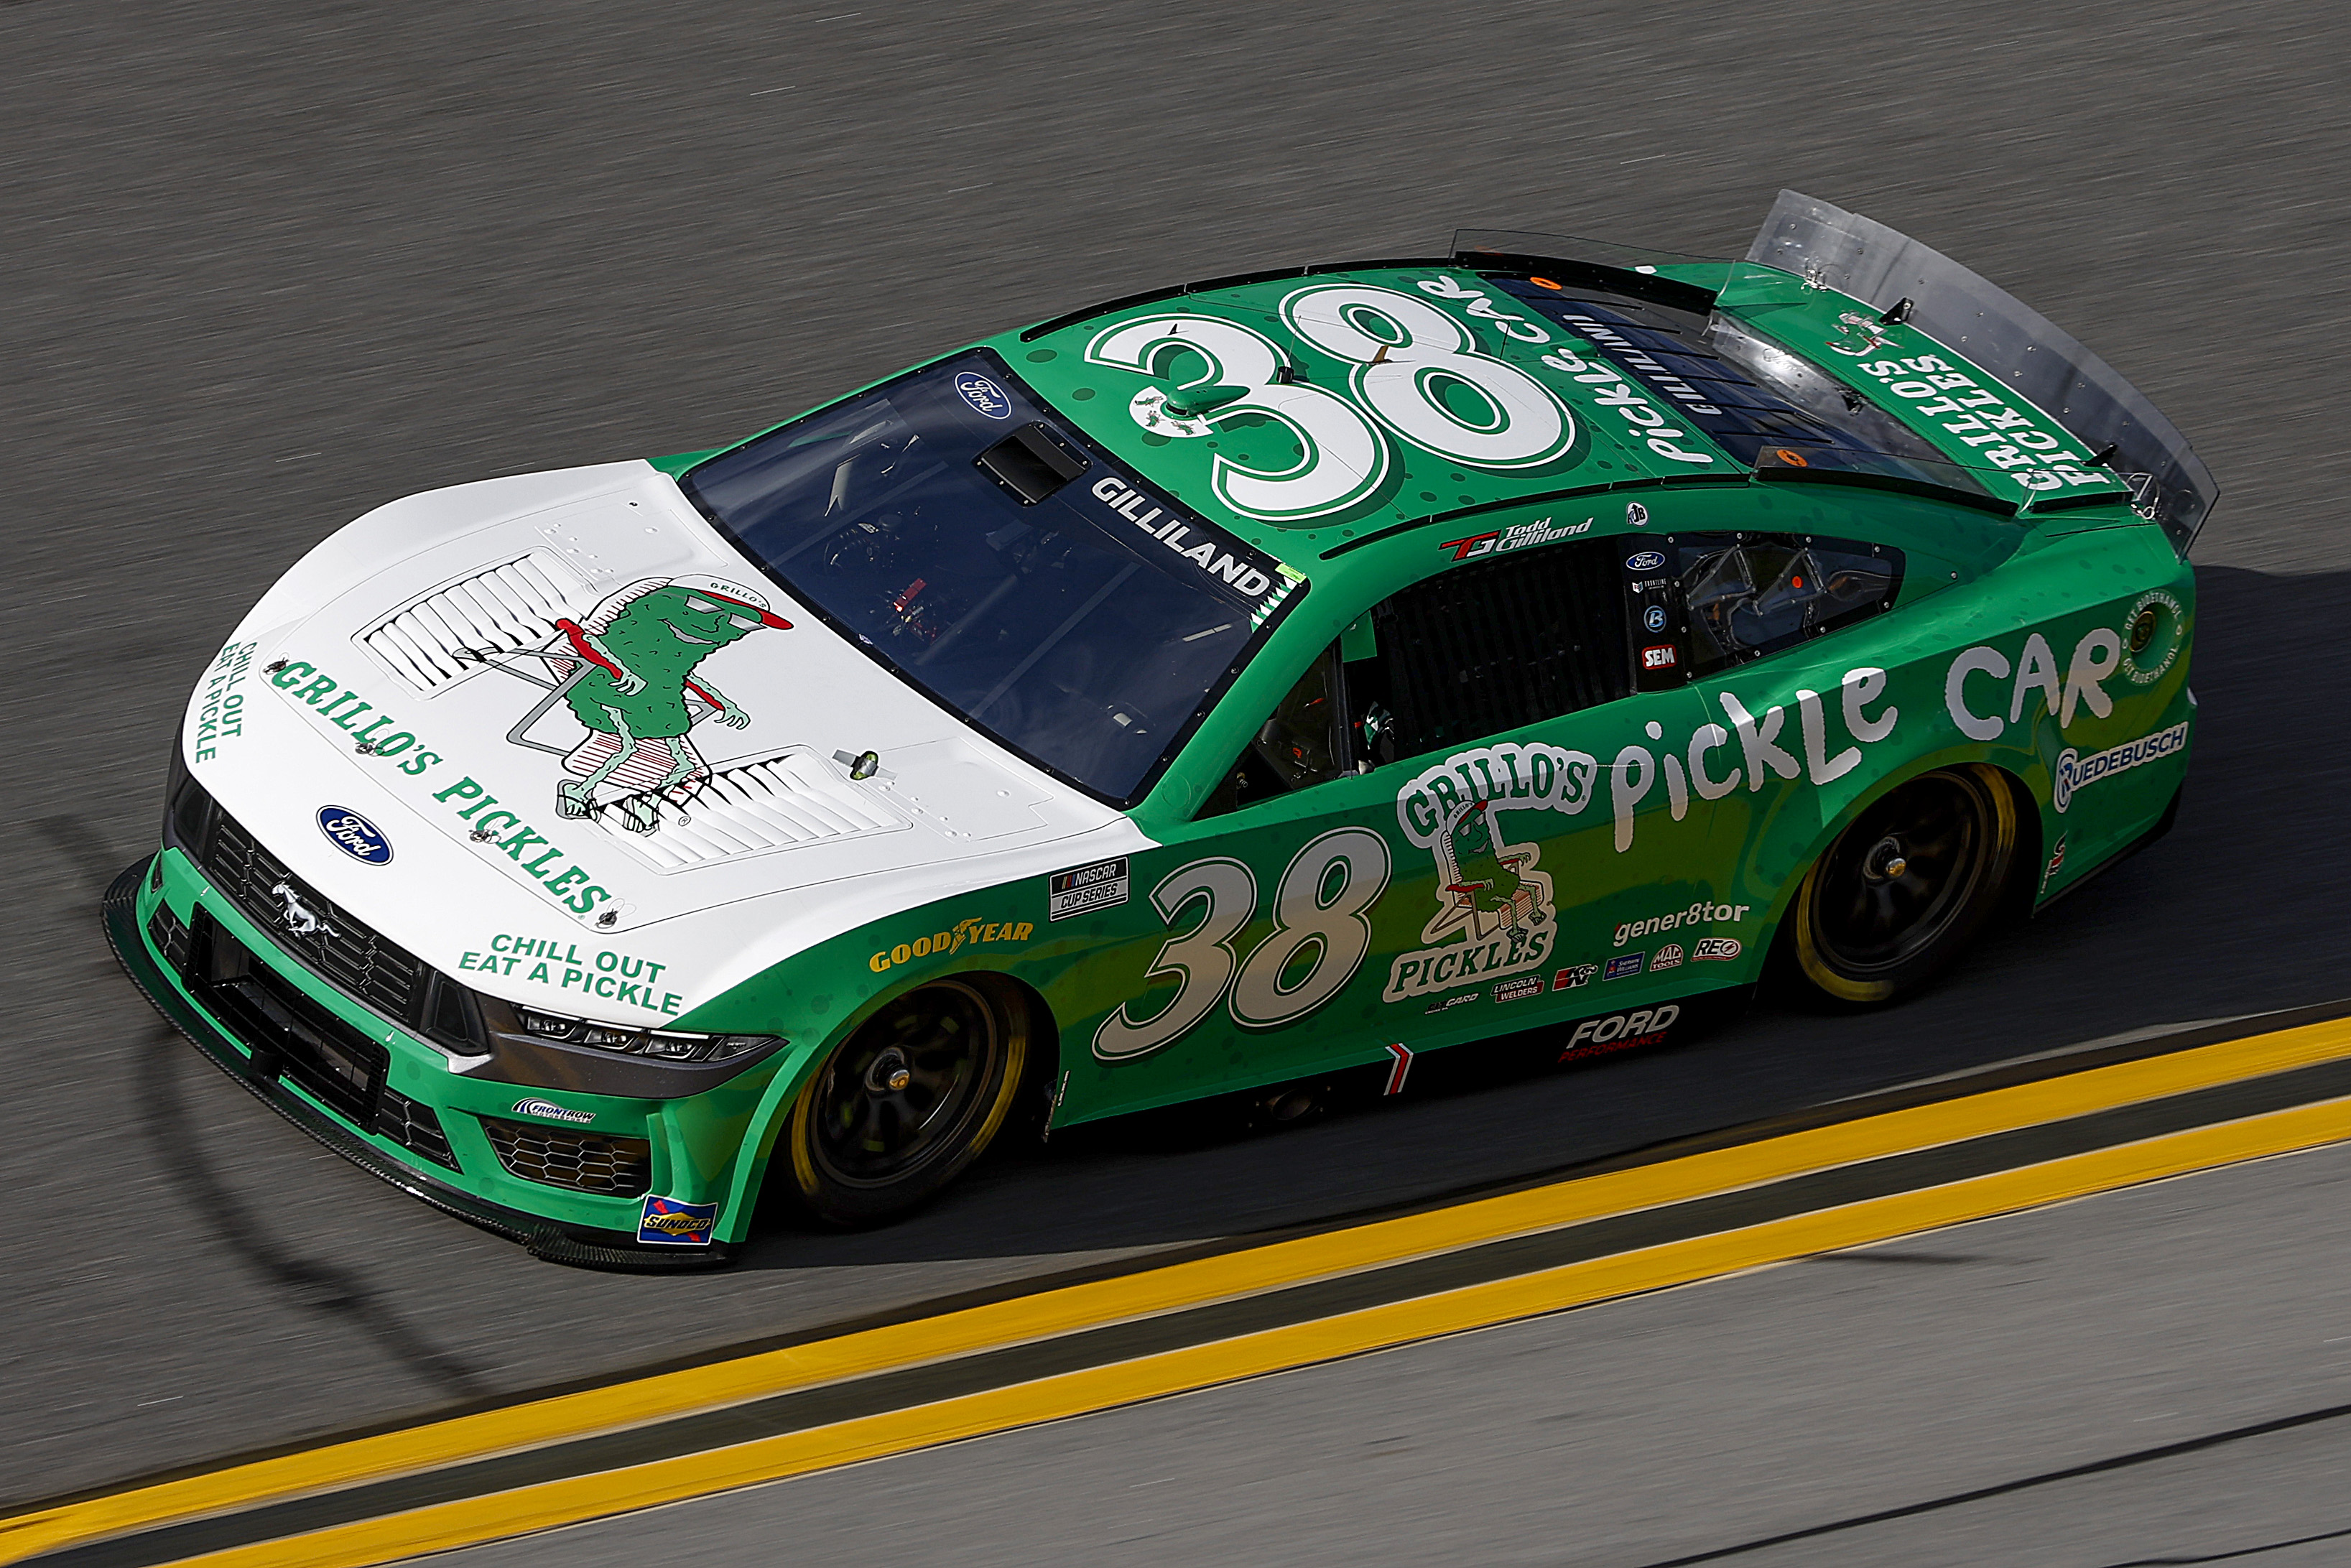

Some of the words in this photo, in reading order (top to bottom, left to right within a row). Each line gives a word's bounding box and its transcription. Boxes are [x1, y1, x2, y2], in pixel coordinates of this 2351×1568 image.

[1416, 275, 1551, 343] CAR
[963, 379, 1003, 414] Ford
[1084, 283, 1577, 521] 38
[1857, 359, 2064, 491] GRILLO'S
[1900, 353, 2113, 486] PICKLES
[1091, 476, 1271, 597] GILLILAND
[1496, 516, 1595, 552] Gilliland
[1506, 516, 1552, 538] Todd
[1633, 553, 1660, 568] Ford
[710, 583, 767, 608] GRILLO'S
[214, 641, 241, 672] EAT
[226, 641, 258, 692] CHILL
[1644, 647, 1675, 667] SEM
[207, 674, 227, 690] A
[1944, 628, 2121, 741] CAR
[195, 688, 223, 764] PICKLE
[221, 694, 244, 737] OUT
[271, 661, 445, 776] GRILLO'S
[432, 776, 612, 914] PICKLES
[1405, 753, 1589, 837] GRILLO'S
[325, 814, 383, 857] Ford
[1060, 892, 1083, 909] CUP
[1082, 882, 1118, 903] SERIES
[1075, 863, 1117, 886] NASCAR
[1092, 826, 1392, 1061] 38
[1613, 902, 1750, 947] gener8tor
[491, 934, 583, 966] CHILL
[595, 951, 667, 984] OUT
[868, 919, 1034, 974] GOODYEAR
[1391, 930, 1549, 993] PICKLES
[1652, 958, 1682, 969] TOOLS
[1653, 945, 1682, 963] MAC
[458, 951, 522, 976] EAT
[527, 962, 550, 984] A
[560, 968, 683, 1017] PICKLE
[1493, 977, 1537, 993] LINCOLN
[1500, 985, 1539, 1001] WELDERS
[1557, 1031, 1668, 1064] PERFORMANCE
[1565, 1004, 1680, 1049] FORD
[646, 1215, 710, 1230] SUNOCO
